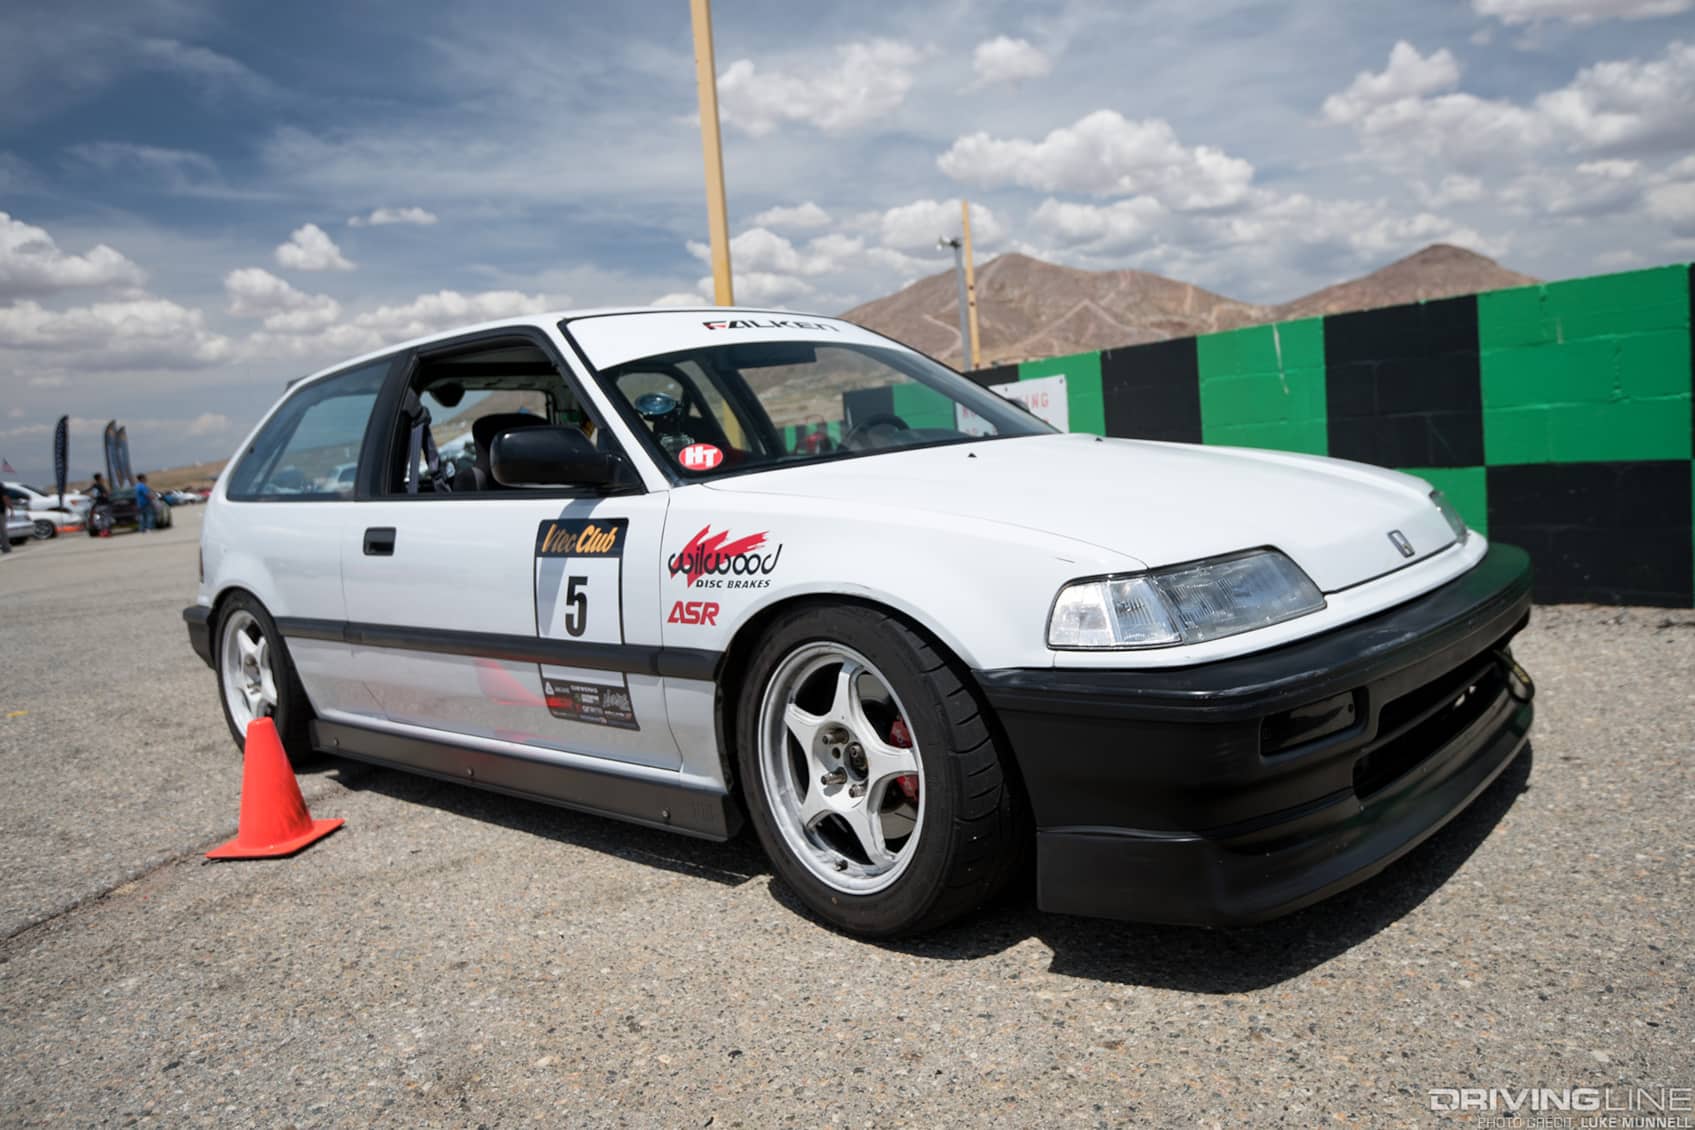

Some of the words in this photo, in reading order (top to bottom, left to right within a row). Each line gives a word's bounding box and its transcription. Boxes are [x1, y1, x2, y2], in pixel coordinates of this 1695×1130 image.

[702, 319, 840, 333] FALKEN
[684, 445, 718, 468] HT
[575, 524, 619, 553] Club
[696, 579, 724, 589] DISC
[727, 579, 772, 589] BRAKES
[565, 575, 589, 637] 5
[667, 600, 720, 626] ASR
